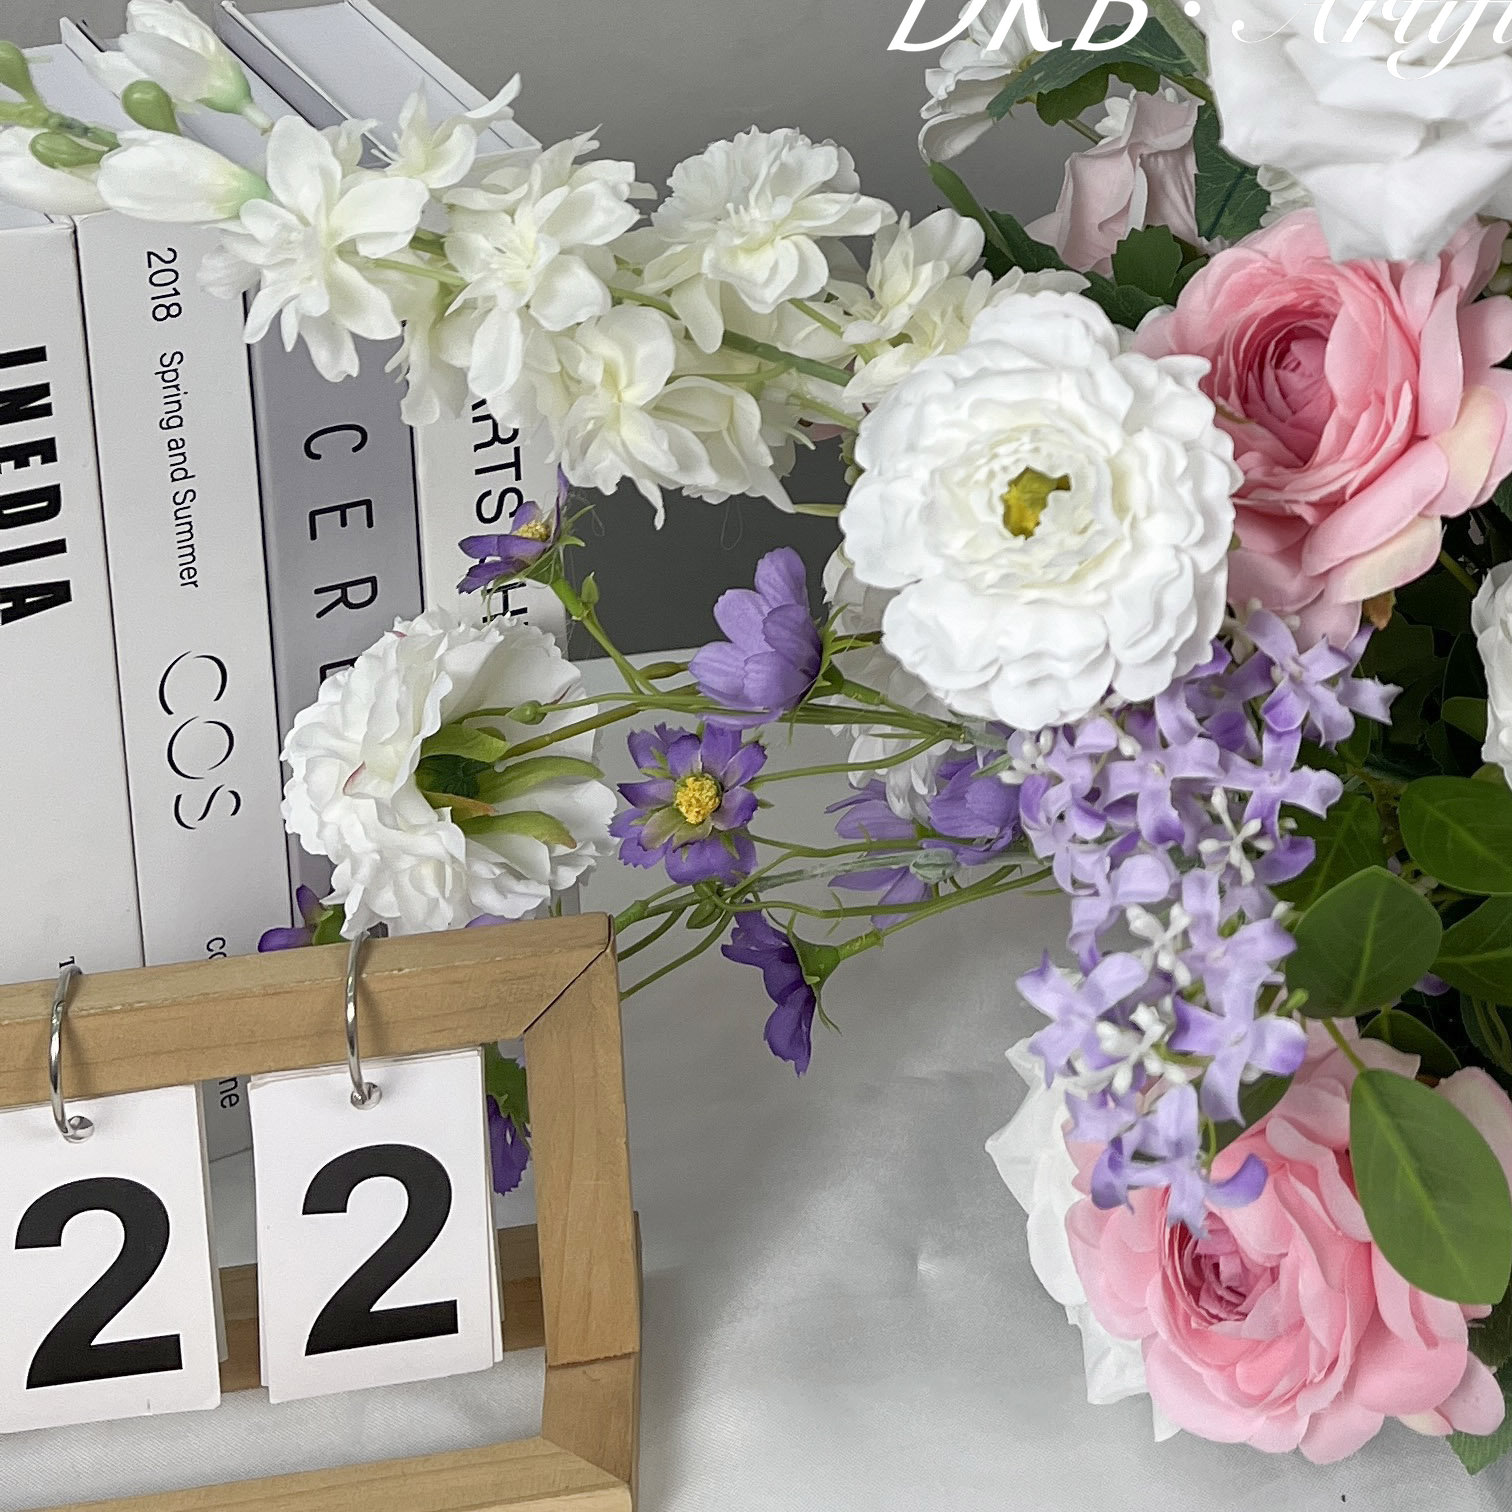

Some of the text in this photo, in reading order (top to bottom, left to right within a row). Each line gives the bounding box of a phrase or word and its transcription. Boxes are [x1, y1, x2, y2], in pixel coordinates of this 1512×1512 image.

[146, 247, 200, 589] 2018 Spring and Summer
[158, 650, 242, 830] COS
